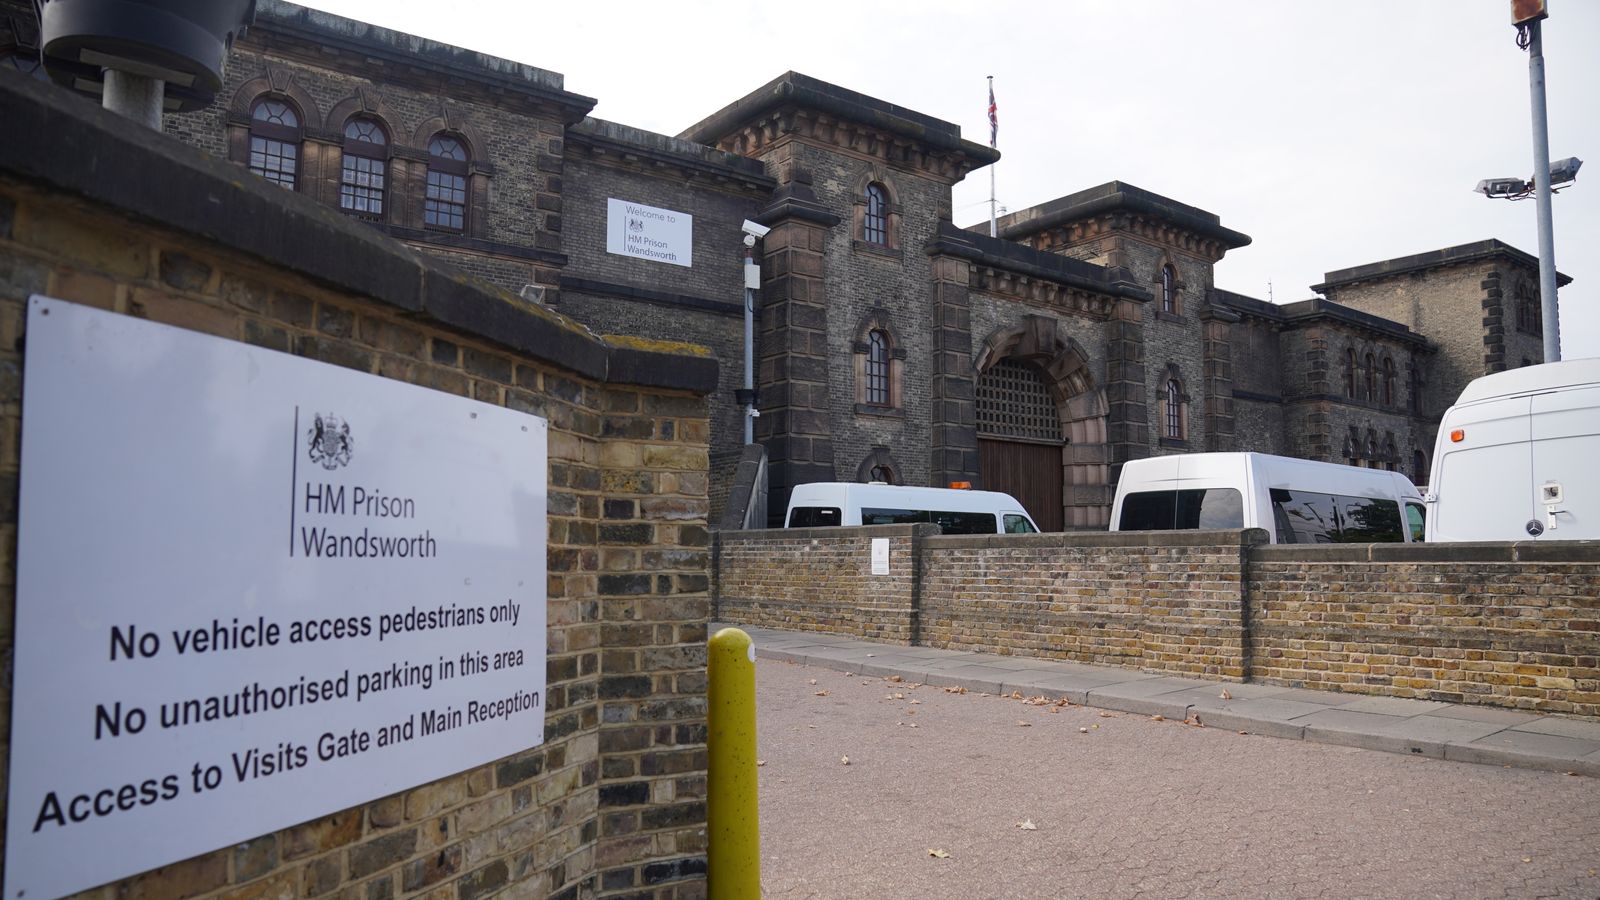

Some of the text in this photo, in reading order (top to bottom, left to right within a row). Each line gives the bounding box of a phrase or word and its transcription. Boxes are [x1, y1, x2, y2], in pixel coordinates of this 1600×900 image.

[626, 205, 676, 223] Welcome to
[627, 244, 677, 260] Wandsworth
[628, 234, 668, 248] HM Prison
[306, 482, 414, 518] HM Prison
[302, 527, 436, 558] Wandsworth
[110, 599, 520, 661] No vehicle access pedestrians only
[95, 650, 523, 740] No unauthorised parking in this area
[32, 690, 539, 833] Access to Visits Gate and Main Reception
